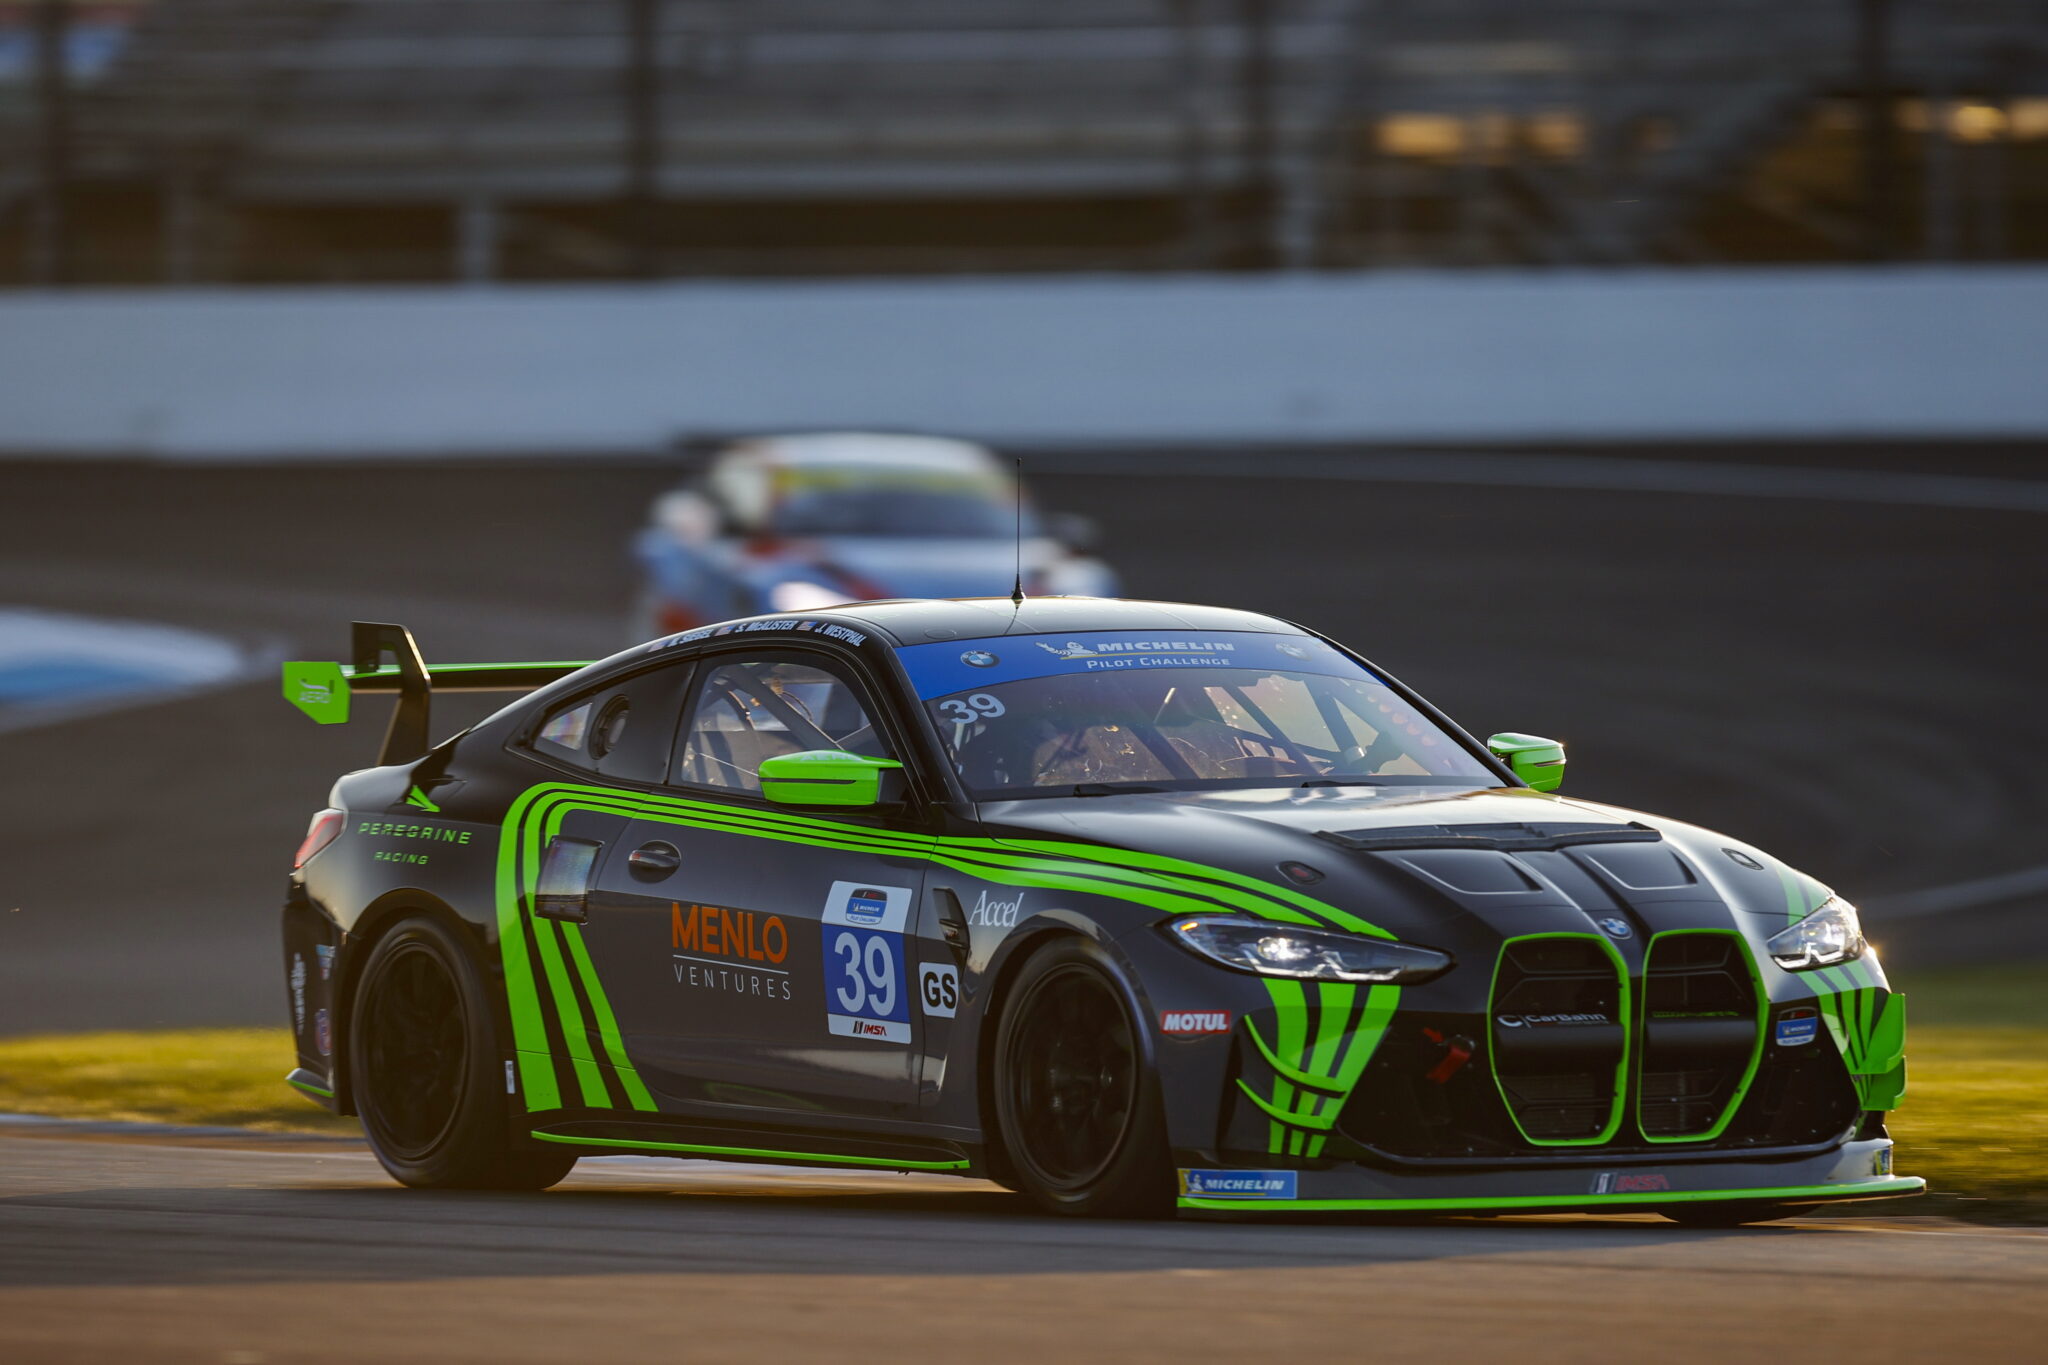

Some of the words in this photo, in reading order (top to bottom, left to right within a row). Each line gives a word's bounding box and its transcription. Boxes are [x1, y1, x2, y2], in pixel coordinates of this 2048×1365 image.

[823, 624, 867, 647] WESTPHAL
[1096, 642, 1235, 652] MICHELIN
[940, 694, 1005, 724] 39
[358, 822, 473, 845] PEREGRINE
[374, 851, 429, 865] RACING
[968, 889, 1025, 928] Accel
[672, 902, 789, 964] MENLO
[673, 963, 792, 1000] VENTURES
[834, 931, 896, 1017] 39
[923, 971, 957, 1010] GS
[864, 1023, 888, 1037] IMSA
[1163, 1013, 1229, 1031] MOTUL
[1204, 1179, 1285, 1191] MICHELIN
[1615, 1174, 1671, 1192] IMSA
